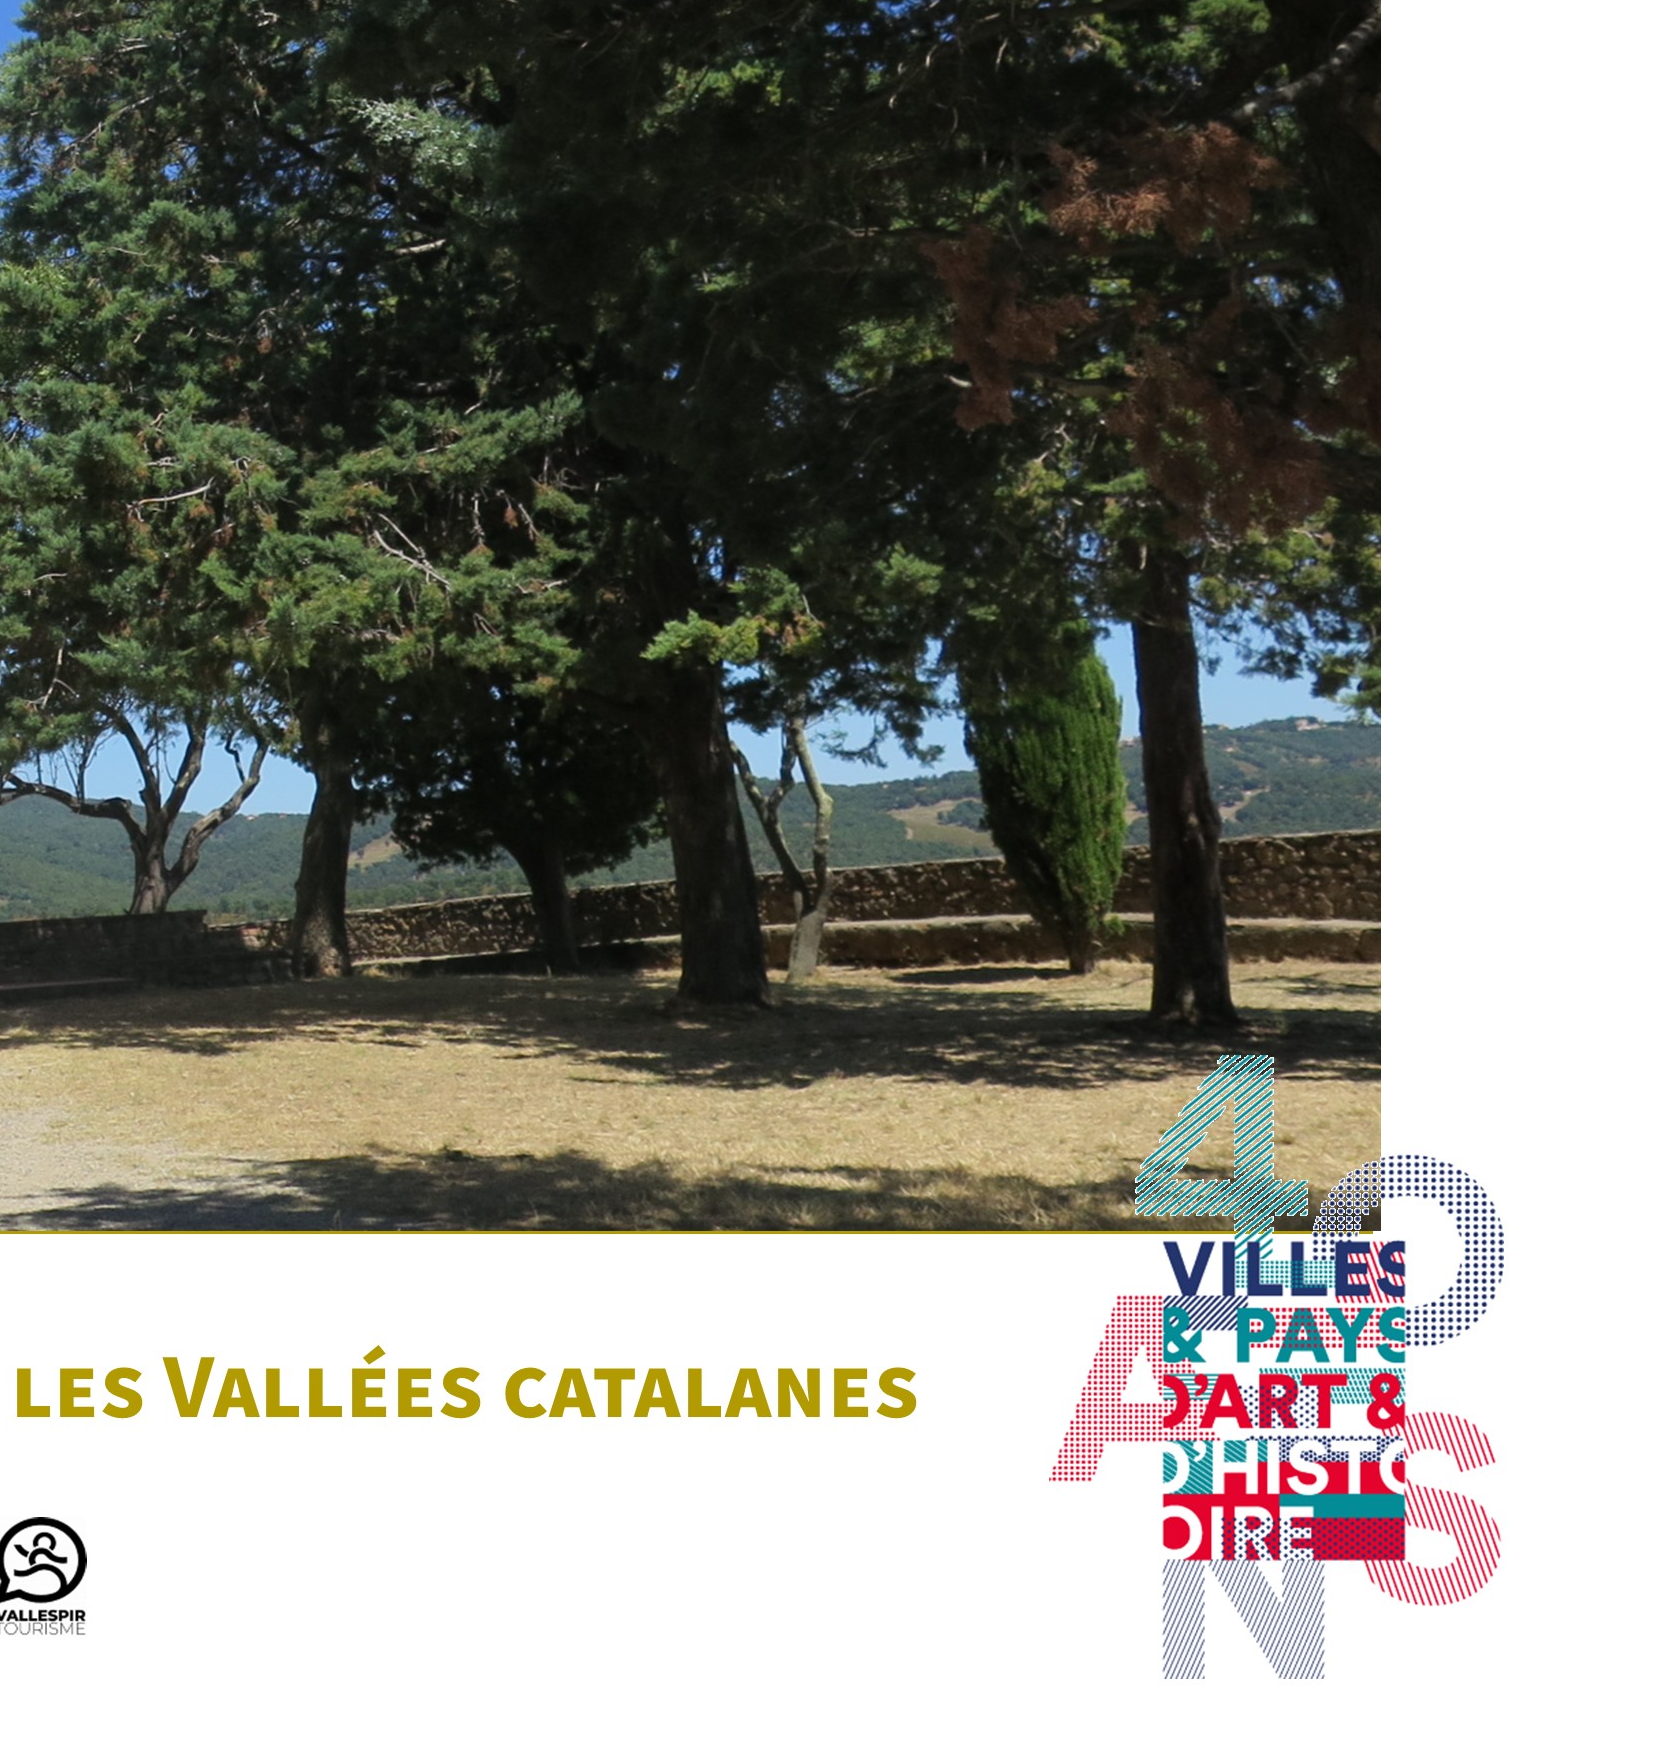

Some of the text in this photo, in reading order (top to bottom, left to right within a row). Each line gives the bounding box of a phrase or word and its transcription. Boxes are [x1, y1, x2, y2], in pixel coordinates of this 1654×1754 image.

[1163, 1240, 1406, 1296] VILLES
[1163, 1306, 1406, 1363] & PAYS
[1366, 1373, 1406, 1429] &
